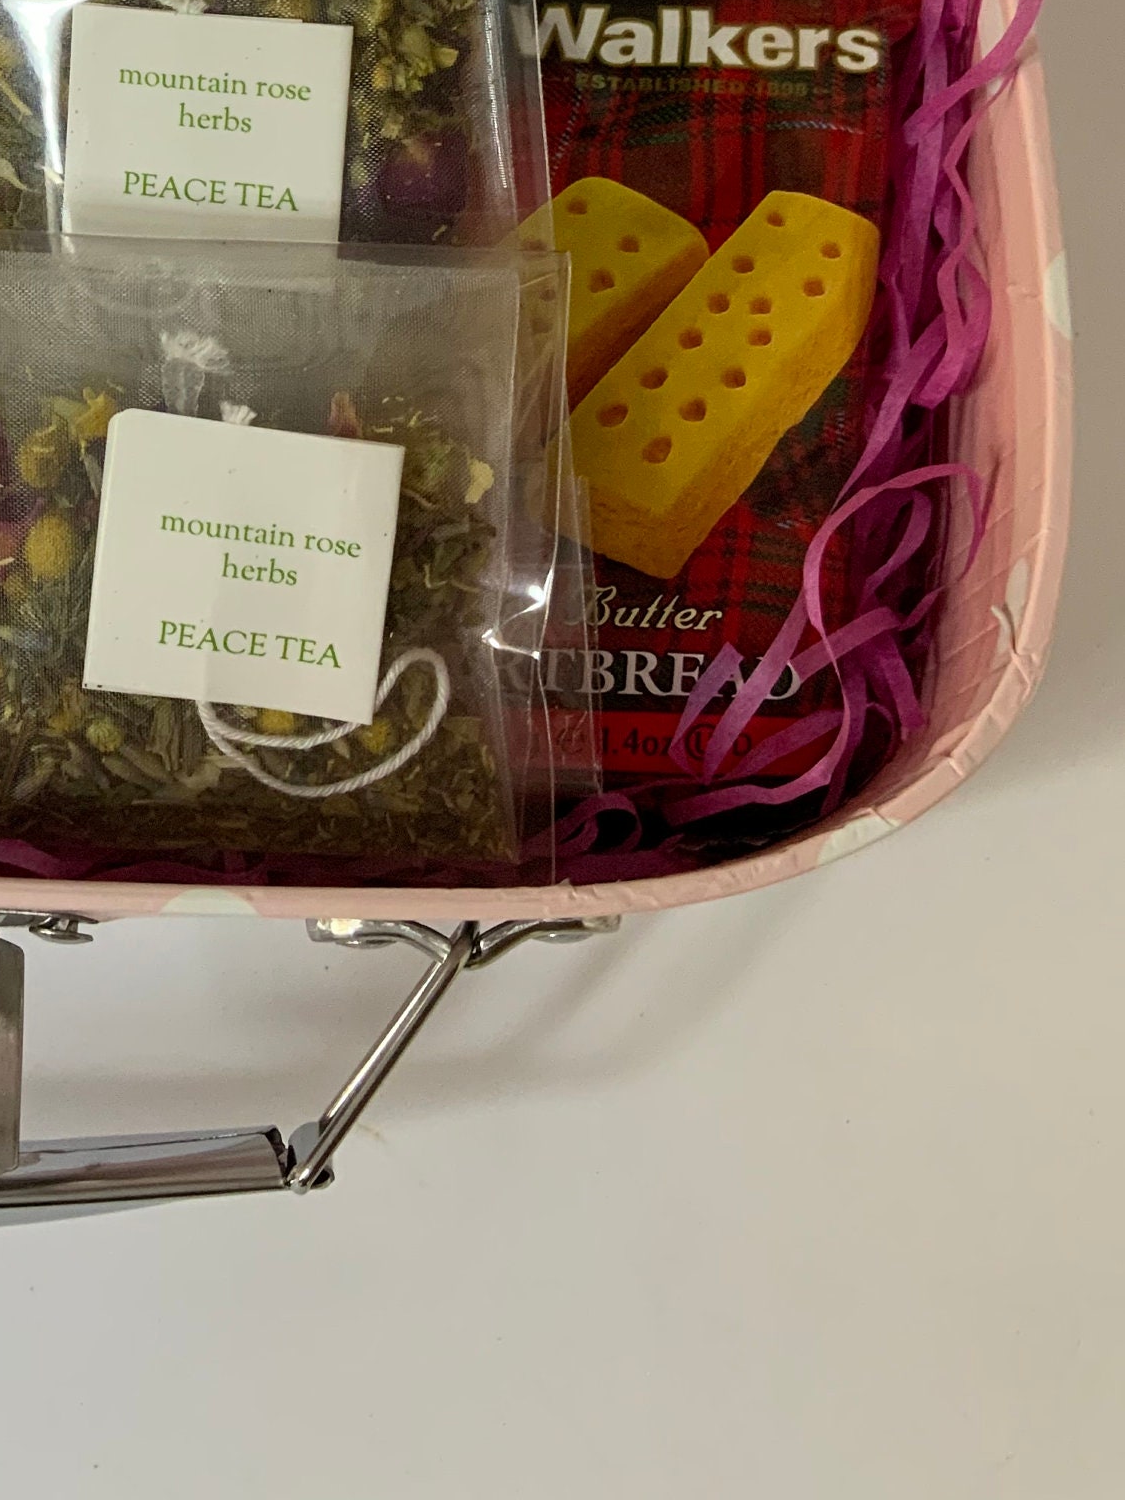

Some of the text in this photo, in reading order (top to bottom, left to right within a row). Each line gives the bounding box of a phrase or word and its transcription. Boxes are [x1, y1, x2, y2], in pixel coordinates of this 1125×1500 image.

[508, 3, 884, 73] Walkers
[119, 68, 311, 101] mountain rose
[576, 75, 745, 94] ESTABLISHED
[179, 103, 252, 133] herbs
[123, 171, 299, 212] PEACE TEA
[160, 514, 361, 558] mountain rose
[222, 553, 297, 585] herbs
[565, 585, 723, 630] Butter
[158, 620, 341, 669] PEACE TEA
